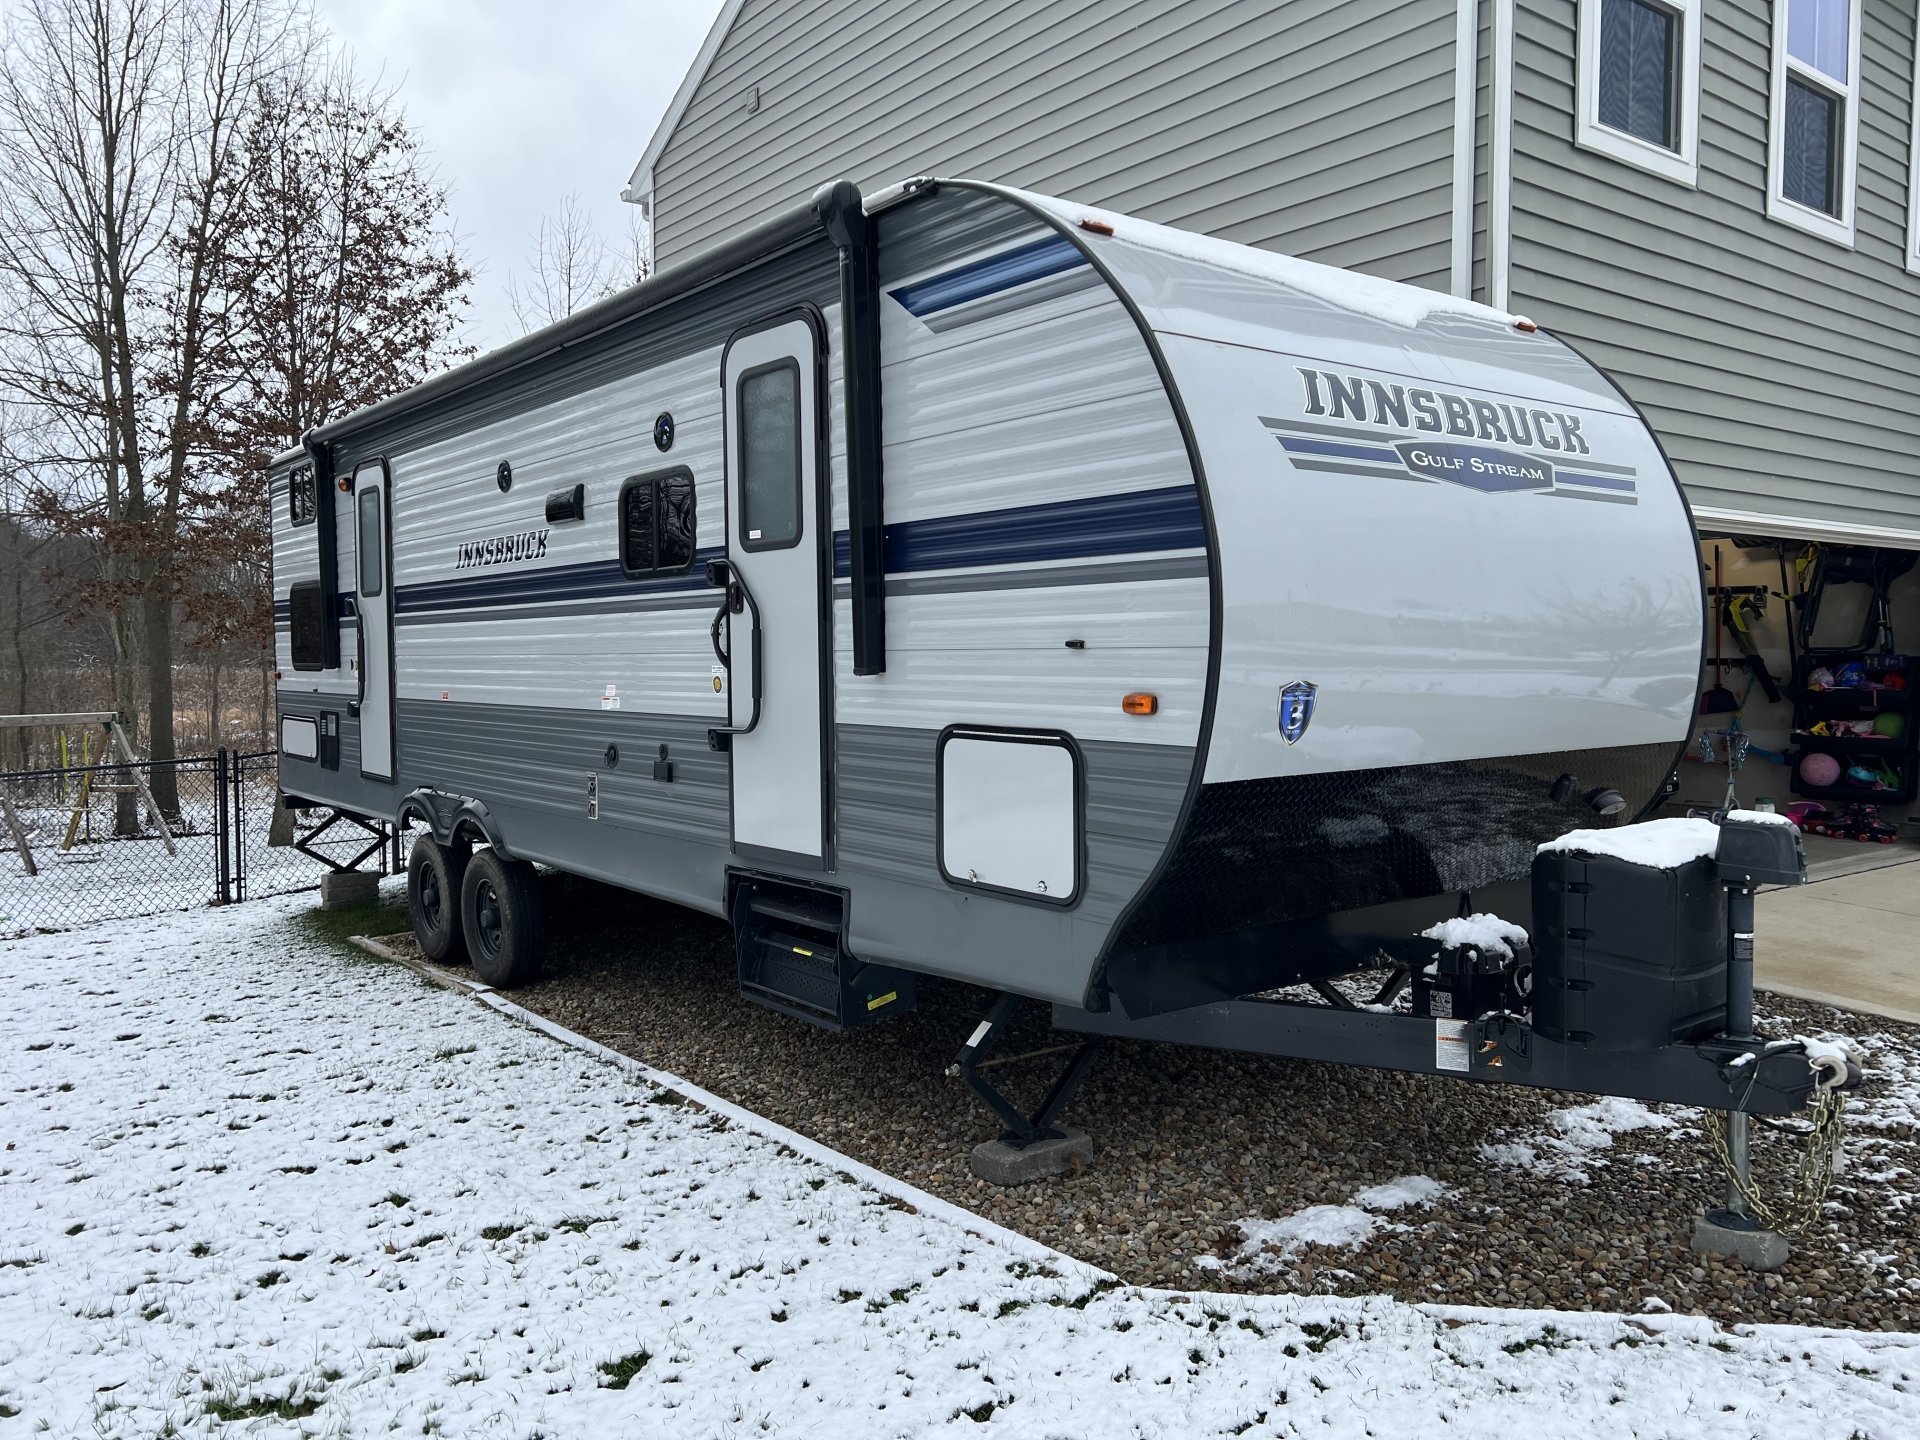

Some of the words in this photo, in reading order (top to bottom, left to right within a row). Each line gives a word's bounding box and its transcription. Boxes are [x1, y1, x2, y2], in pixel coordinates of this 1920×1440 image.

[1294, 366, 1591, 455] INNSBRUCK
[1410, 450, 1465, 470] GULF
[1471, 457, 1545, 481] STREAM
[455, 528, 550, 569] INNSBRUCK
